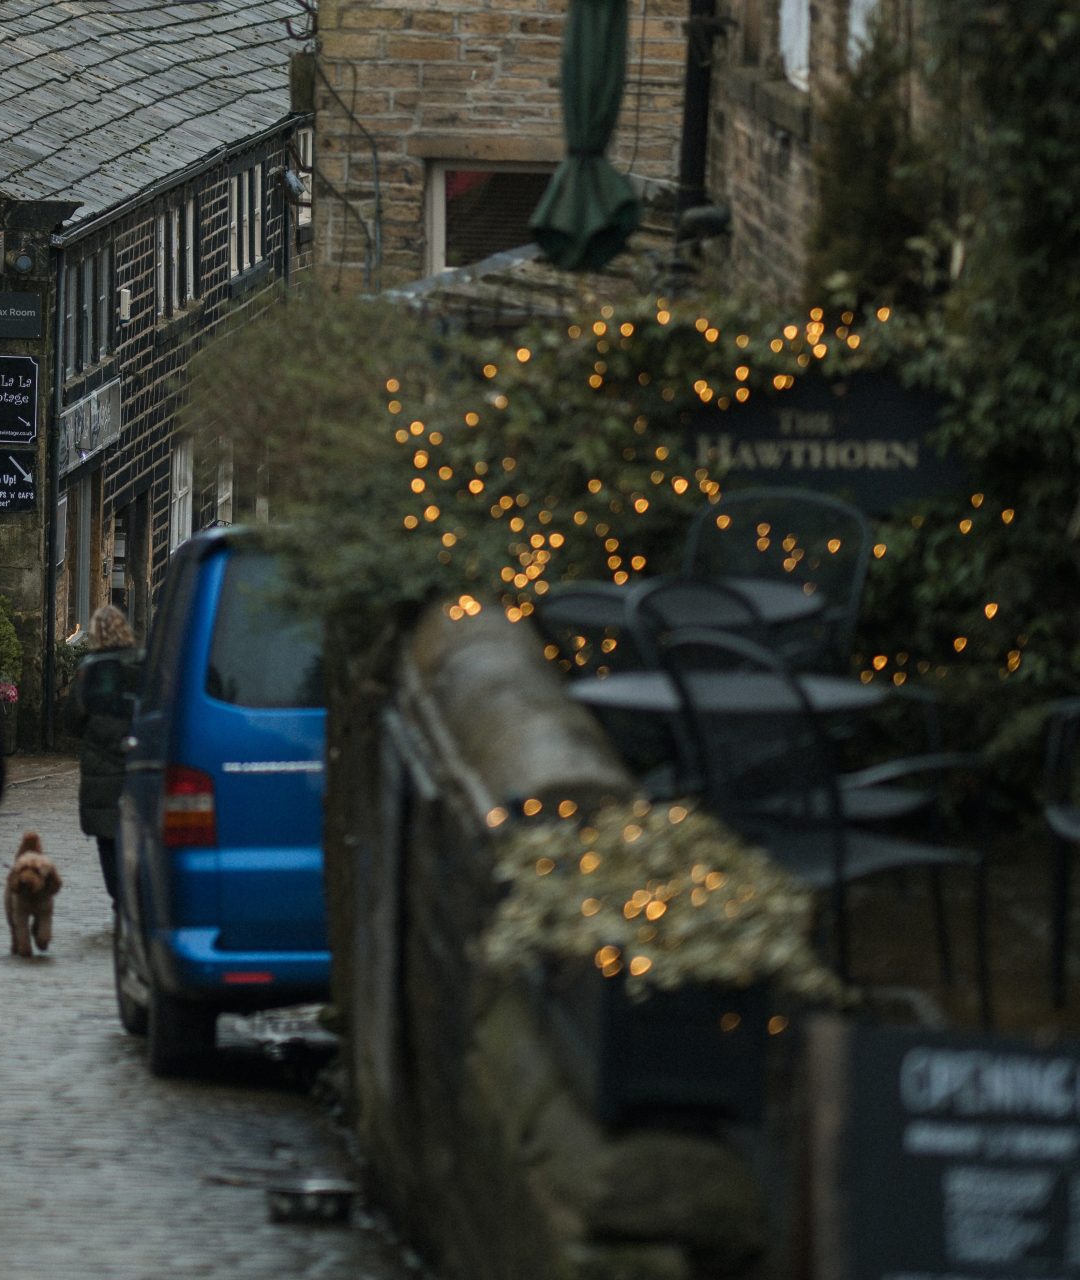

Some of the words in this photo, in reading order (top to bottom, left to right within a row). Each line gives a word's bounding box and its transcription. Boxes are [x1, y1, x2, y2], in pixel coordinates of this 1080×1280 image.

[9, 308, 36, 317] Room
[0, 374, 14, 387] La
[18, 375, 32, 388] La
[3, 474, 17, 486] Up!
